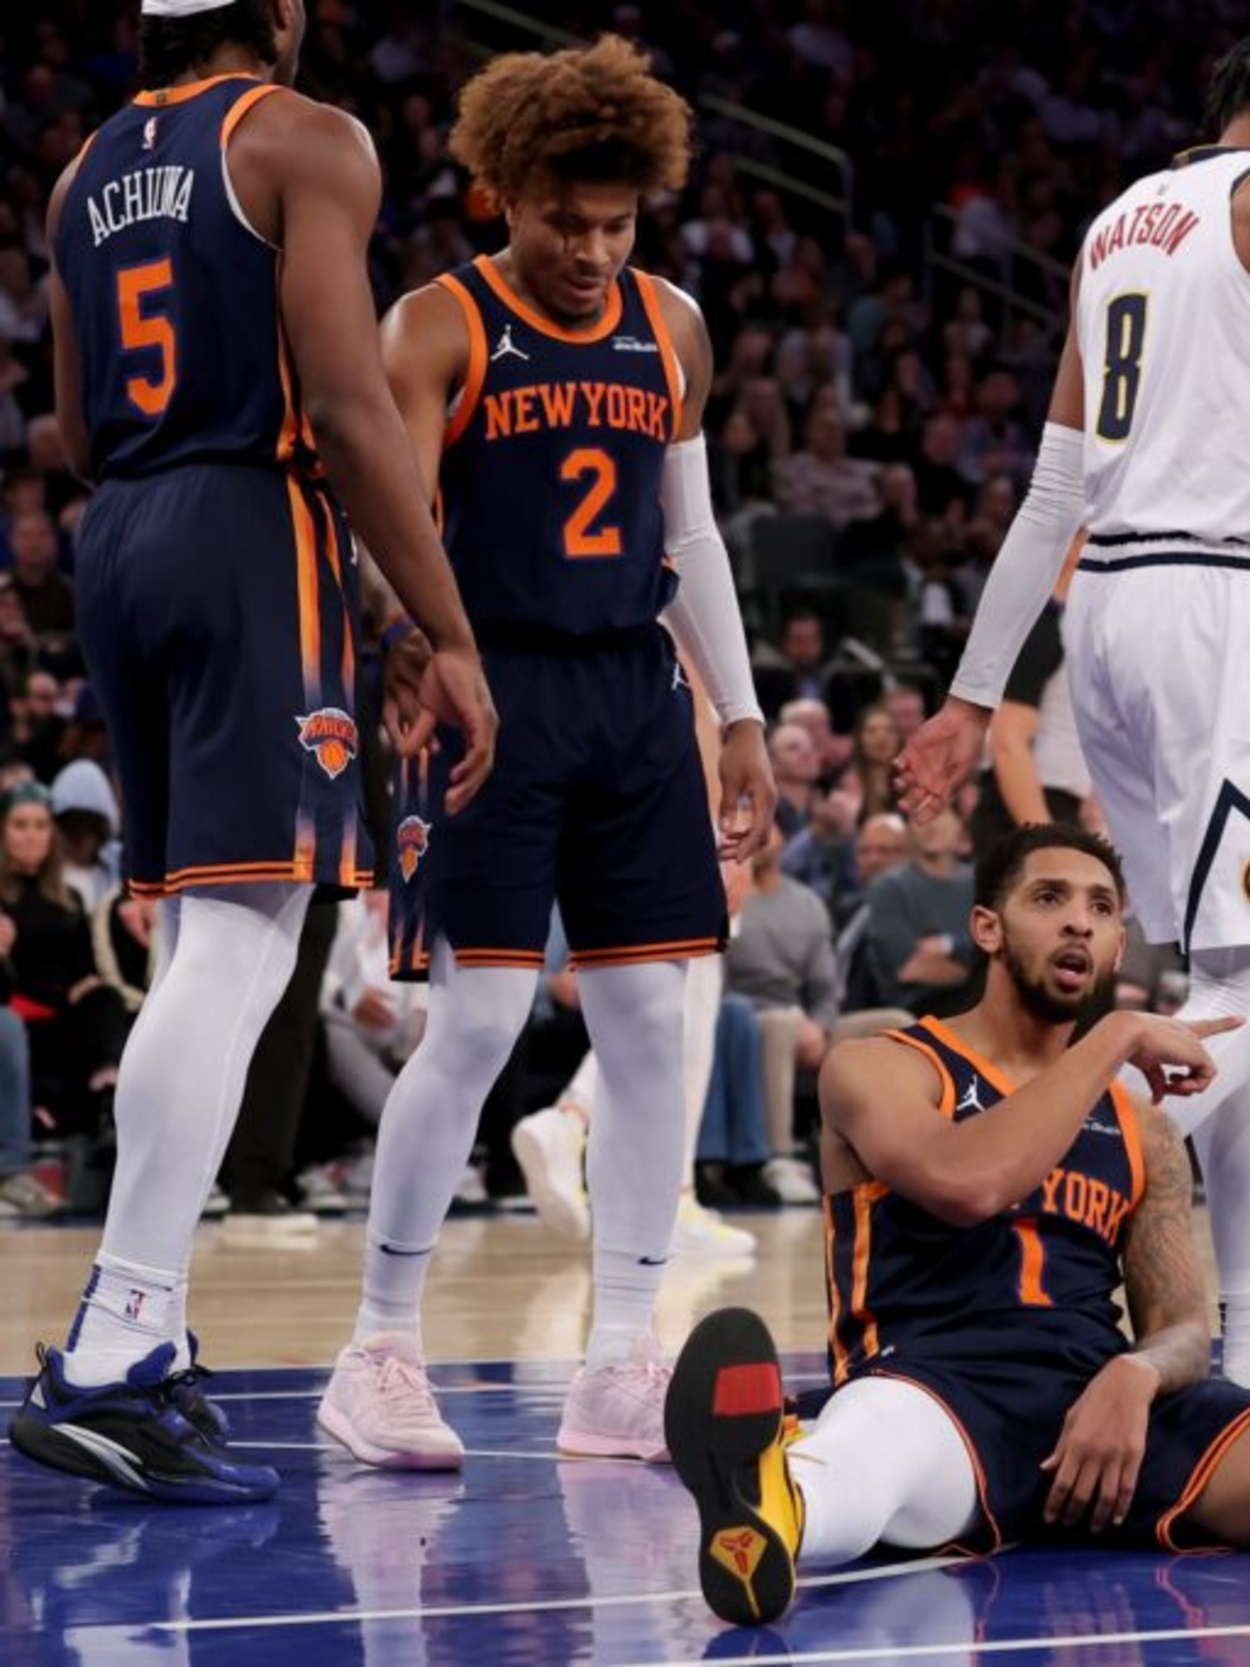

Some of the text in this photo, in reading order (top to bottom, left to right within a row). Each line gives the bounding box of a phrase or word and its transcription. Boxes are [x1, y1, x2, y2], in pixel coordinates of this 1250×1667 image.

[87, 165, 194, 247] ACHIUWA
[1090, 203, 1200, 271] WATSON
[116, 258, 176, 416] 5
[1096, 290, 1149, 443] 8
[484, 382, 668, 442] NEW YORK
[560, 448, 622, 558] 2
[1041, 1169, 1131, 1248] YORK
[1013, 1218, 1055, 1306] 1
